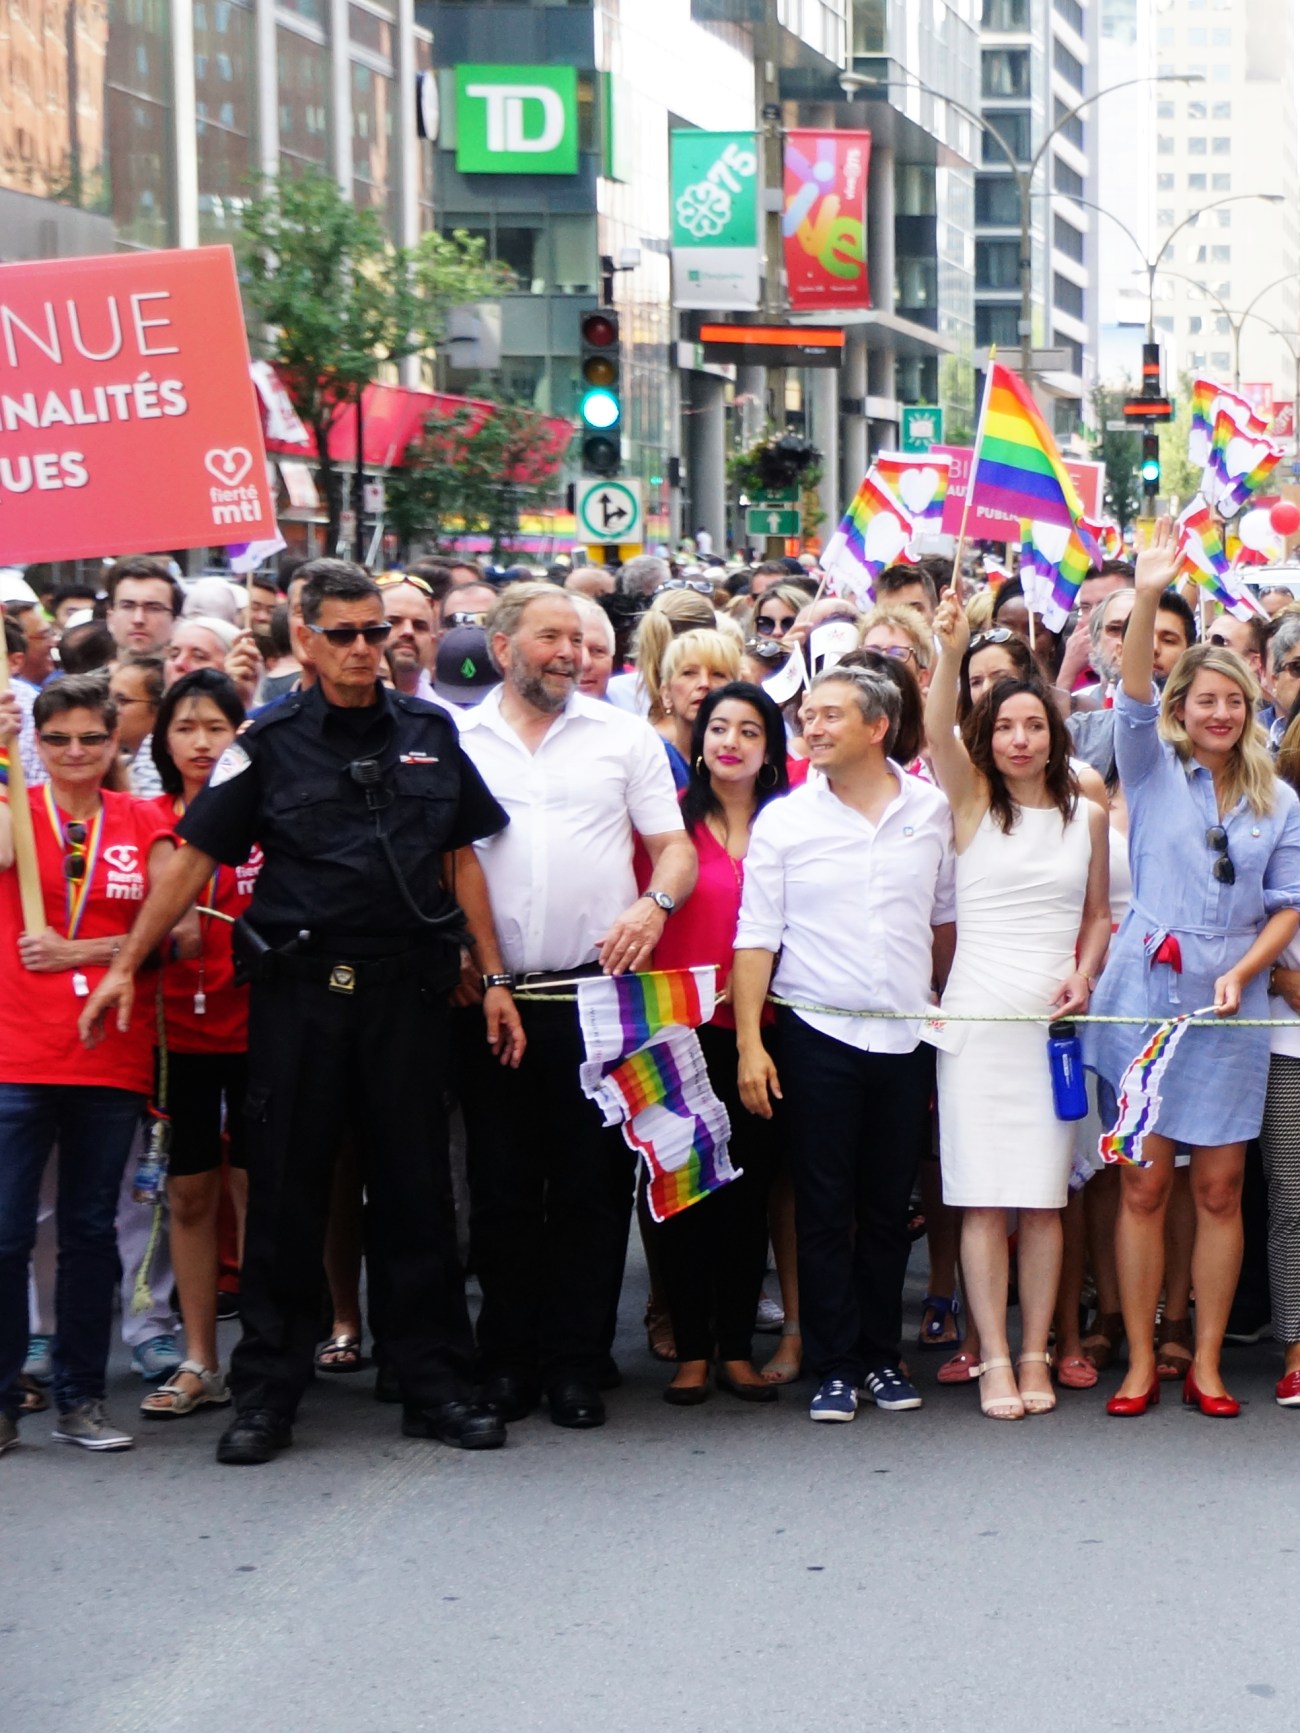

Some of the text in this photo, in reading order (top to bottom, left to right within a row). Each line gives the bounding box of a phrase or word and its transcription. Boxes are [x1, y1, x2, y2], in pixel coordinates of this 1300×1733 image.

[465, 83, 565, 153] TD
[0, 291, 180, 368] NUE
[0, 371, 188, 431] NALITÉS
[209, 484, 258, 503] fierté
[947, 485, 967, 497] AU
[212, 501, 262, 525] mtl
